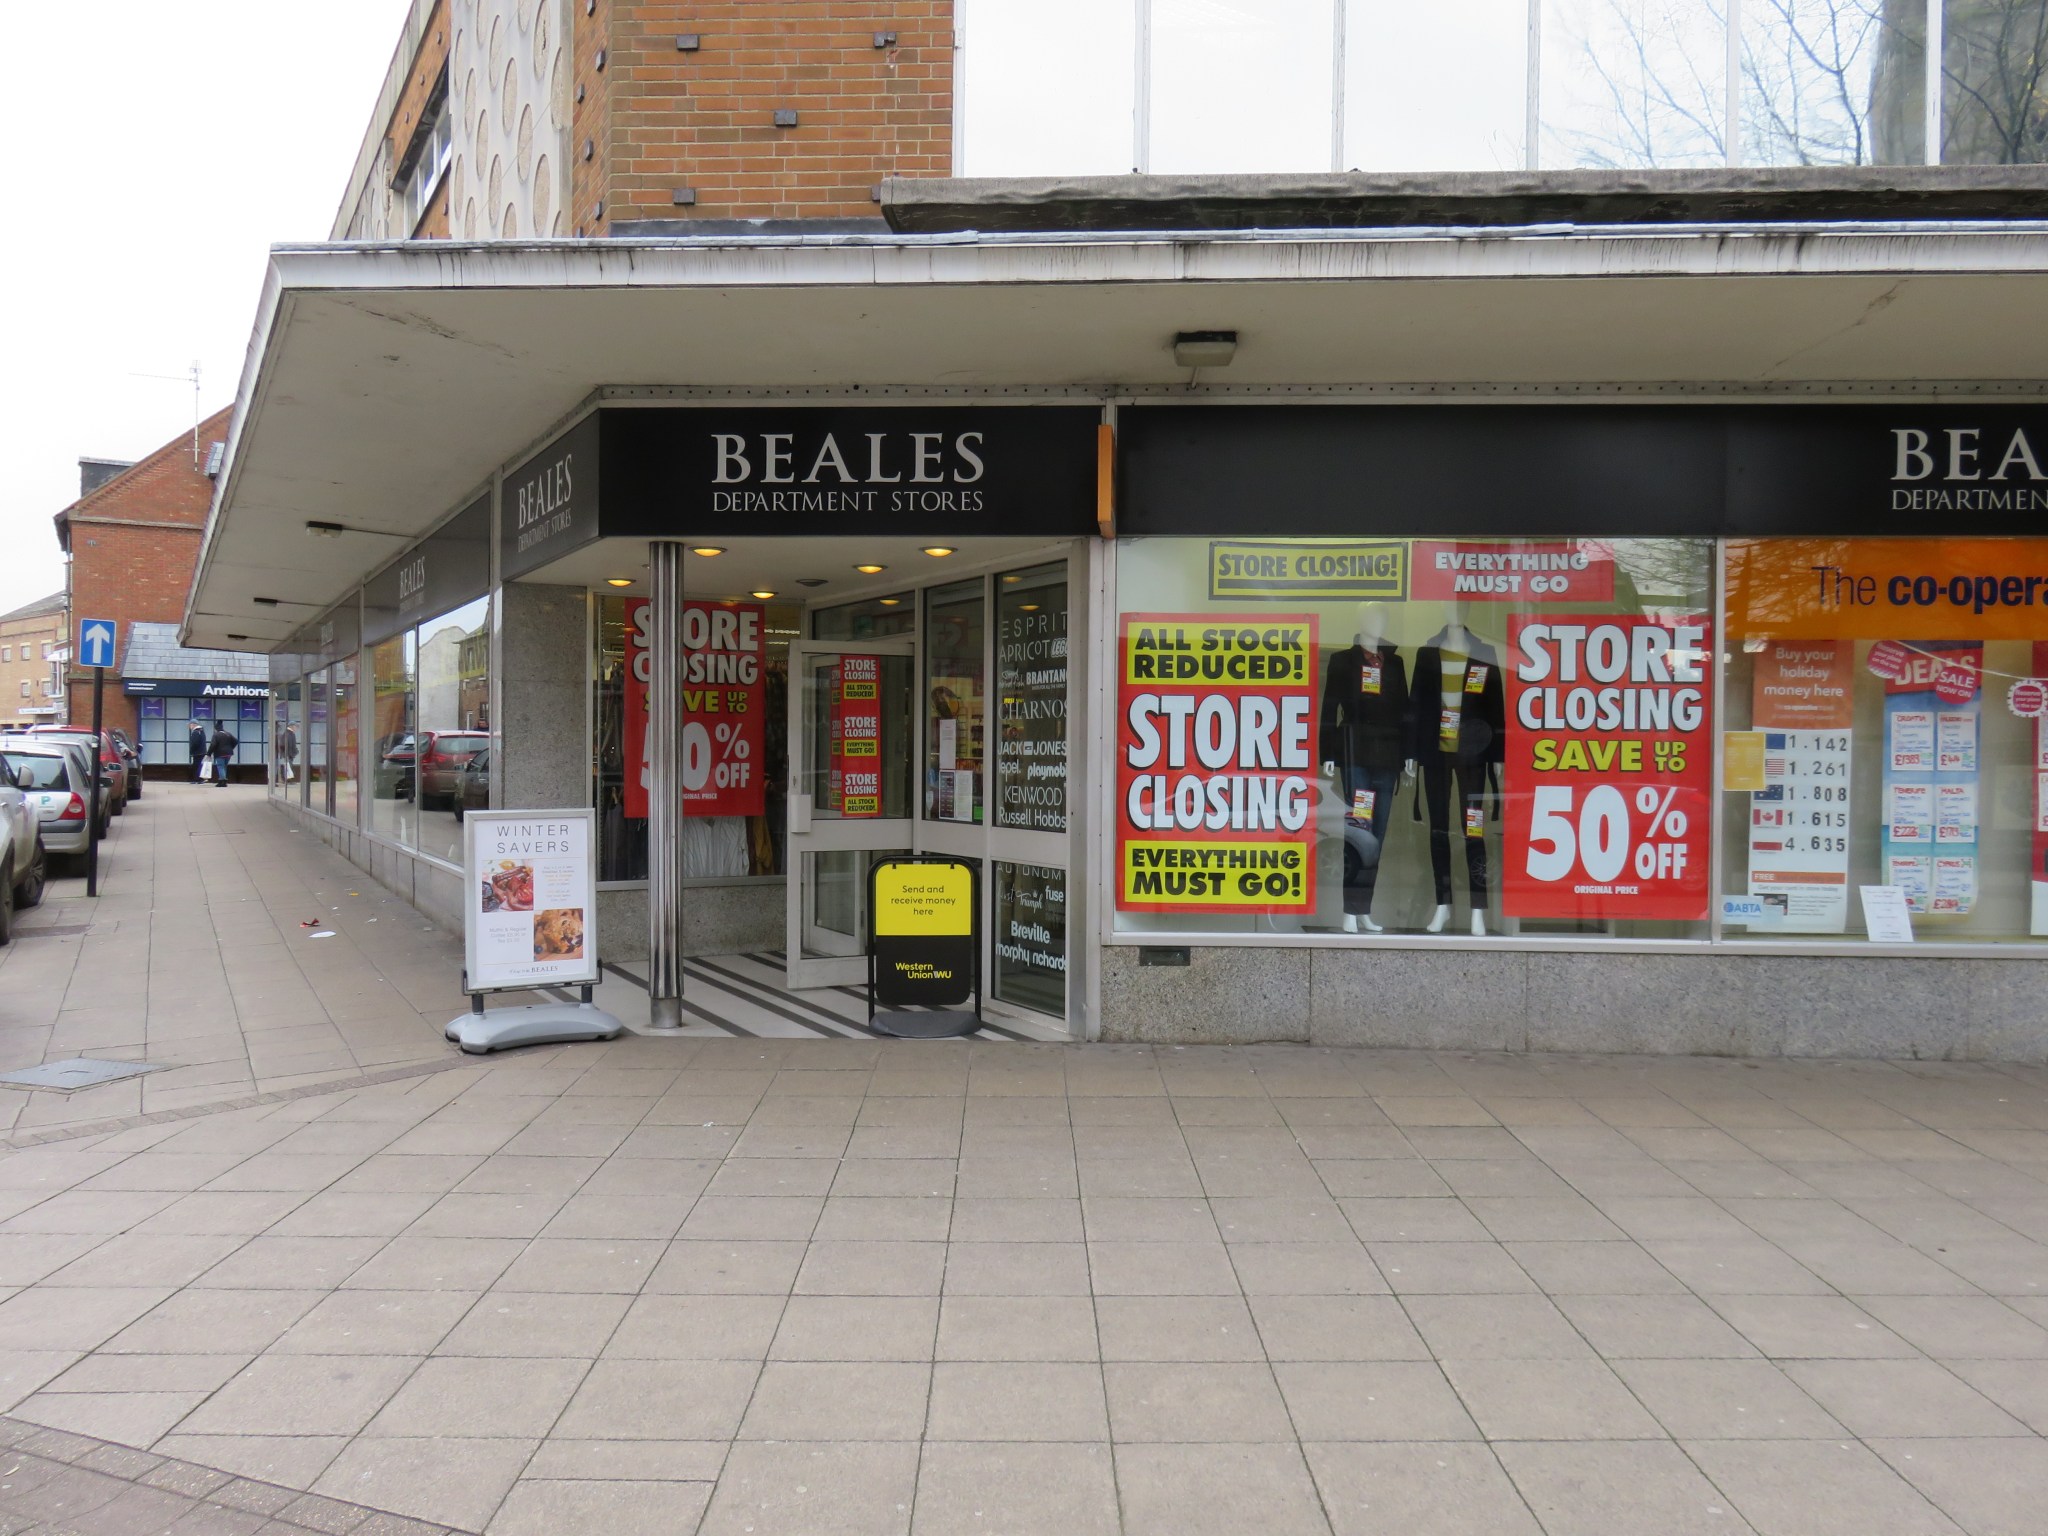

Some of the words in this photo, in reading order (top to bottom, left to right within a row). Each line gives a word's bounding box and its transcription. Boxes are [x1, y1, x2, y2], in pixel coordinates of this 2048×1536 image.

[711, 432, 985, 483] BEALES
[518, 454, 571, 529] BEALES
[713, 491, 877, 513] DEPARTMENT
[891, 491, 985, 513] STORES
[551, 508, 571, 535] STORES
[1218, 553, 1287, 577] STORE
[1295, 553, 1397, 577] CLOSING!
[1435, 552, 1590, 570] EVERYTHING
[1454, 575, 1522, 593] MUST
[1530, 575, 1569, 593] GO
[1811, 566, 1876, 605] The
[1887, 575, 2048, 614] co-oper
[633, 605, 758, 652] SORE
[1002, 611, 1067, 638] ESPRIT
[1135, 629, 1191, 651] ALL
[1201, 629, 1303, 651] STOCK
[1000, 639, 1050, 662] APRICOT
[1051, 637, 1067, 657] LEG
[1518, 624, 1703, 683] STORE
[1776, 647, 1801, 662] Buy
[1804, 651, 1834, 662] your
[633, 650, 758, 684] CSING
[844, 659, 876, 671] STORE
[1134, 655, 1303, 680] REDUCED!
[1780, 665, 1830, 681] holiday
[844, 671, 876, 680] CLOSING
[1026, 668, 1068, 685] BRANTAN
[1939, 671, 1975, 689] SALE
[203, 684, 269, 697] Ambitions
[727, 691, 748, 701] UP
[1764, 686, 1811, 699] money
[1814, 684, 1844, 696] here
[1936, 685, 1958, 695] NOW
[1958, 689, 1972, 698] ON
[727, 703, 748, 713] TO
[1518, 687, 1702, 732] CLOSING
[844, 716, 877, 728] STORE
[844, 728, 877, 738] CLOSING
[1127, 693, 1310, 769] STORE
[997, 741, 1023, 755] JACK
[1033, 741, 1067, 755] JONES
[1788, 734, 1847, 752] 1.142
[1533, 739, 1643, 772] SAVE
[1655, 741, 1686, 756] UP
[1655, 757, 1686, 773] TO
[1788, 760, 1847, 776] 1.261
[714, 762, 750, 789] OFF
[845, 773, 877, 785] STORE
[845, 785, 878, 795] CLOSING
[1004, 785, 1062, 806] KENWOOD
[1788, 786, 1847, 801] 1.808
[1127, 774, 1309, 832] CLOSING
[999, 806, 1032, 826] Russell
[1034, 809, 1067, 829] Hobbs
[1786, 811, 1846, 828] 1.615
[497, 825, 569, 837] WINTER
[497, 841, 569, 854] SAVERS
[1784, 836, 1846, 853] 4.635
[1132, 848, 1301, 869] EVERYTHING
[1634, 843, 1687, 879] OFF
[997, 864, 1067, 881] AUTONOM
[1754, 873, 1775, 881] FREE
[902, 885, 924, 893] Send
[926, 885, 944, 893] and
[1132, 872, 1225, 897] MUST
[1238, 872, 1301, 897] GO!
[1574, 885, 1613, 894] ORIGINAL
[1615, 885, 1639, 895] PRICE
[890, 896, 924, 905] receive
[925, 897, 956, 906] money
[1045, 885, 1064, 902] fuse
[913, 908, 934, 916] here
[1734, 903, 1762, 913] ABTA
[1011, 920, 1050, 945] Breville
[995, 943, 1030, 967] morphy
[531, 965, 558, 973] BEALES
[895, 962, 933, 971] Western
[907, 971, 933, 979] Union
